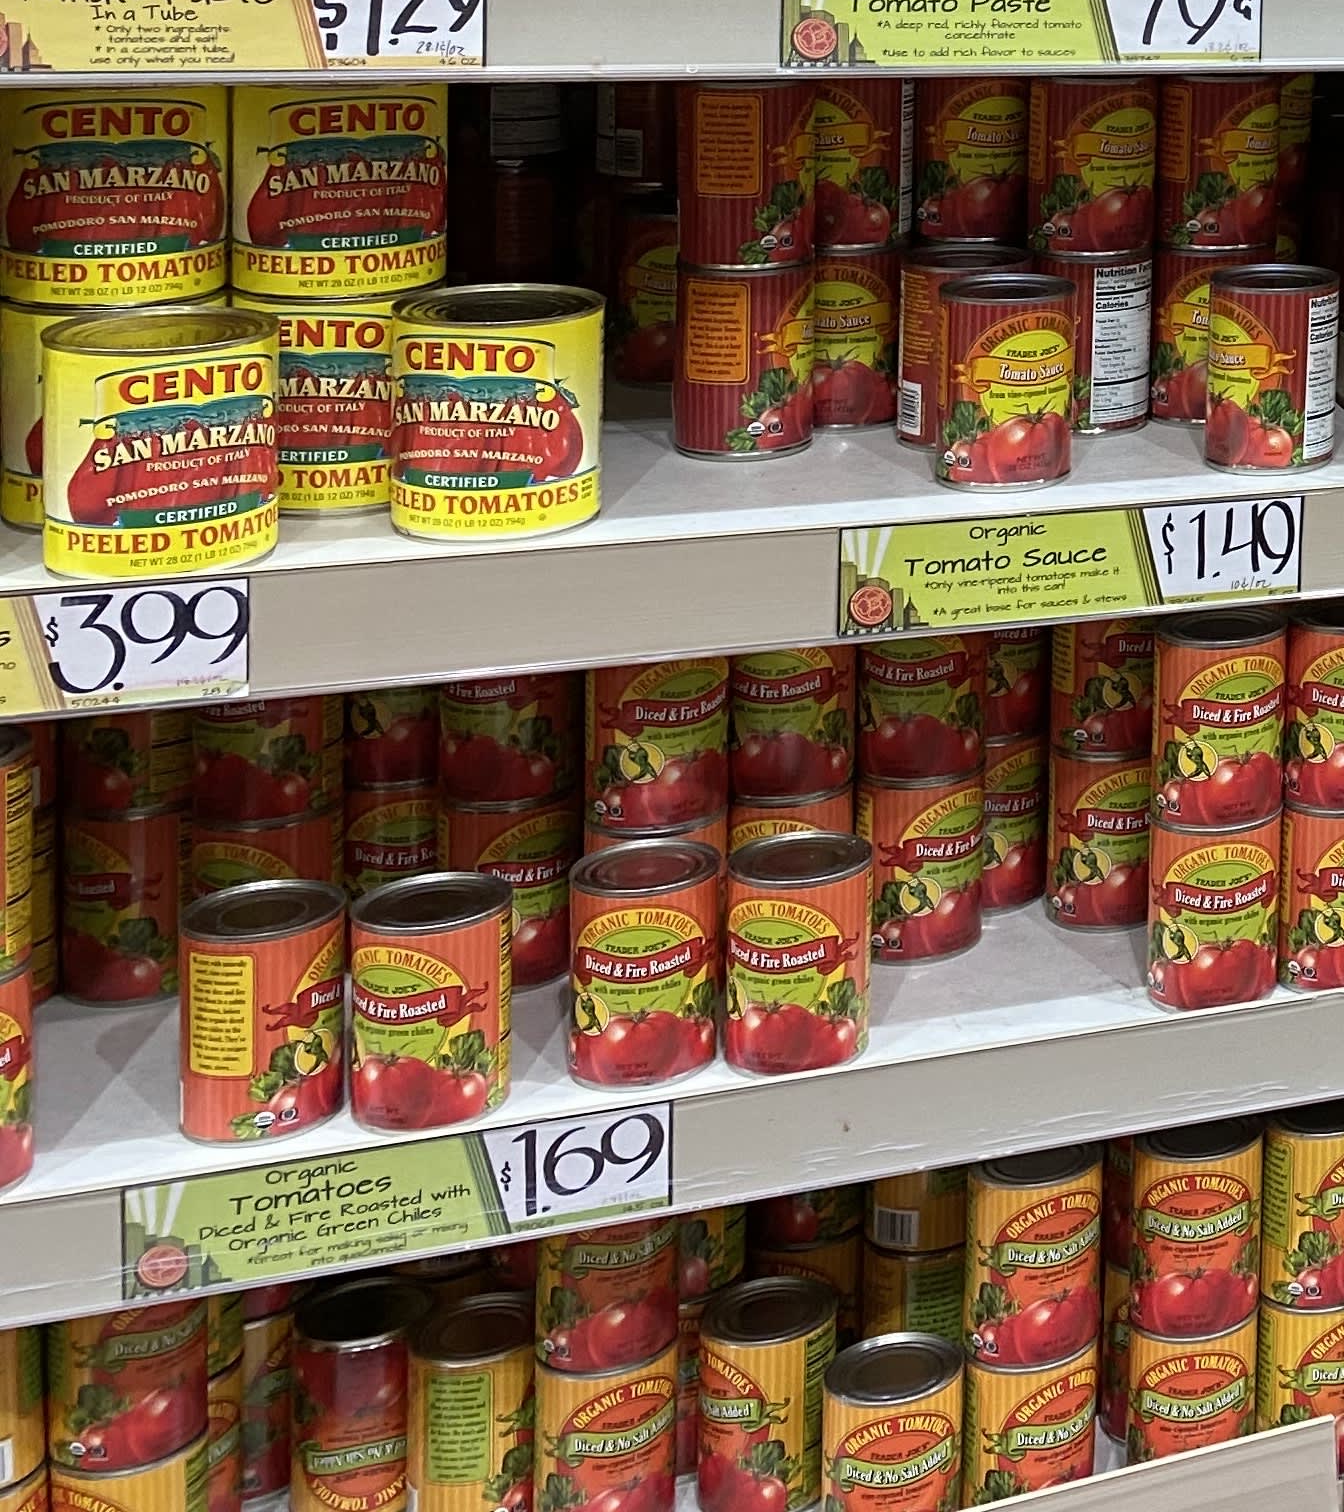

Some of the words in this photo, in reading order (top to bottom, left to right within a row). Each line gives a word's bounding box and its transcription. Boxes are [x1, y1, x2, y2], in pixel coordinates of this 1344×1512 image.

[91, 6, 117, 22] In
[123, 10, 135, 21] a
[142, 5, 198, 22] Tube
[1042, 19, 1082, 30] tomato
[404, 340, 536, 373] CENTO
[118, 360, 264, 406] CENTO
[94, 440, 152, 473] SAN
[160, 423, 276, 456] MARZANO
[154, 501, 238, 524] CERTIFIED
[66, 528, 172, 554] PEELED
[969, 521, 1047, 547] Organic
[1162, 500, 1295, 581] $1.49
[904, 551, 1012, 577] Tomato
[1022, 545, 1107, 568] Sauce
[45, 586, 249, 694] $3.99
[265, 1158, 358, 1187] Organic
[500, 1112, 665, 1218] $1.69
[199, 1217, 256, 1243] Diced
[265, 1211, 282, 1228] &
[289, 1204, 331, 1227] Fire
[340, 1190, 423, 1219] Roasted
[430, 1184, 471, 1201] with
[228, 1173, 393, 1217] Tomatoes
[228, 1225, 304, 1254] Organic
[316, 1214, 381, 1240] Green
[386, 1204, 442, 1225] Chiles
